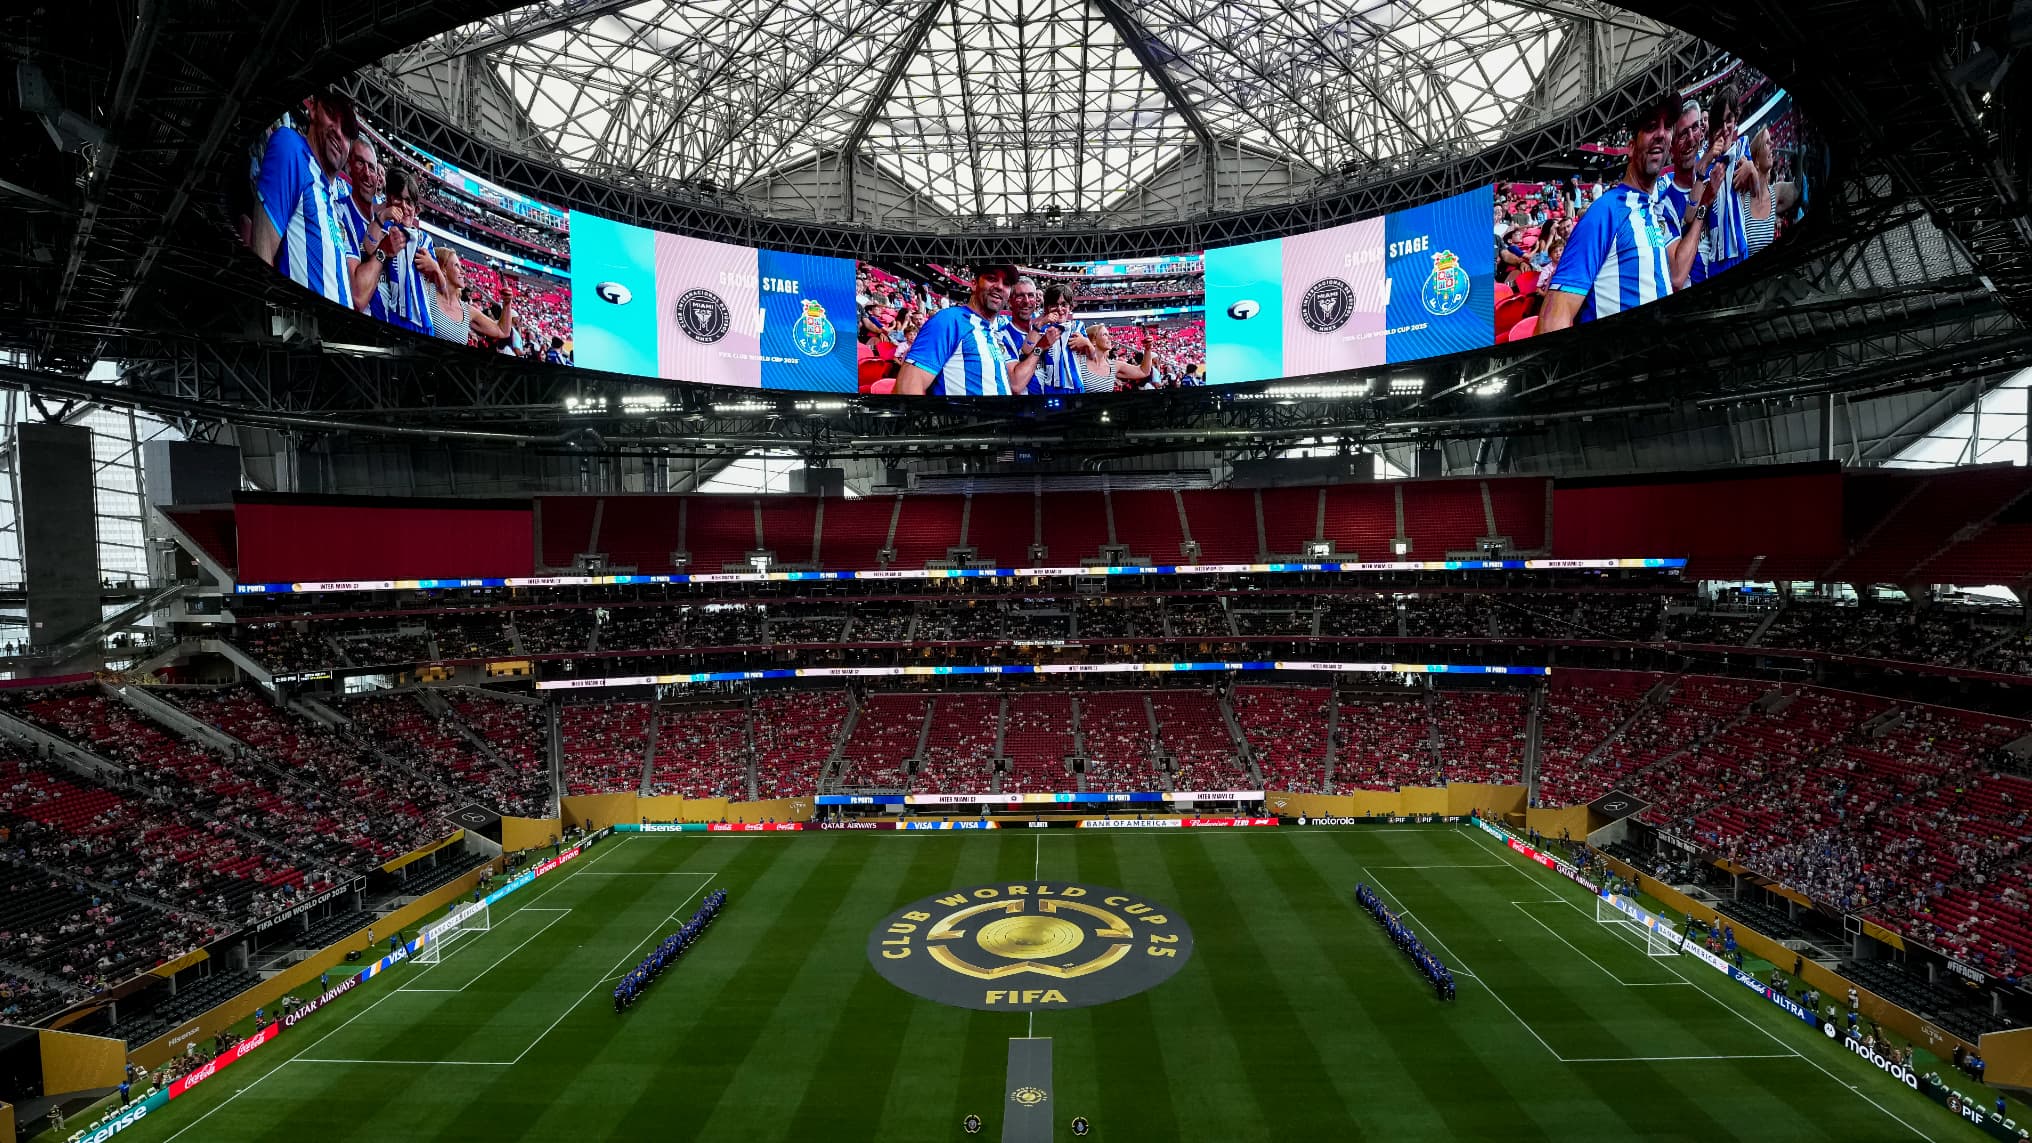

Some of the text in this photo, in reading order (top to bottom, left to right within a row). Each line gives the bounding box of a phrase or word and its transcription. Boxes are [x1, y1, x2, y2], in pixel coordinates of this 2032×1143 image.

[1390, 235, 1428, 258] STAGE
[763, 277, 799, 294] STAGE
[1373, 328, 1396, 337] WORLD
[640, 824, 682, 832] Hisense
[1312, 816, 1354, 825] motorola
[559, 850, 579, 864] Lenovo
[536, 861, 556, 876] Lenovo
[1556, 864, 1575, 880] QATAR
[257, 919, 273, 932] FIFA
[273, 910, 292, 925] CLUB
[293, 899, 318, 915] WORLD
[318, 892, 331, 904] CUP
[881, 885, 1179, 960] CLUB WORLD CUP 25
[387, 946, 408, 964] VISA
[1686, 942, 1720, 964] AMERICA
[1947, 960, 1985, 984] #FIFACWC
[285, 977, 355, 1026] QATAR AIRWAYS
[986, 989, 1069, 1004] FIFA
[1772, 992, 1806, 1019] ULTRA
[168, 1026, 200, 1047] Hisense
[1845, 1036, 1918, 1090] motorola
[184, 1061, 217, 1088] Coca-Cola
[1962, 1105, 1984, 1124] PIF
